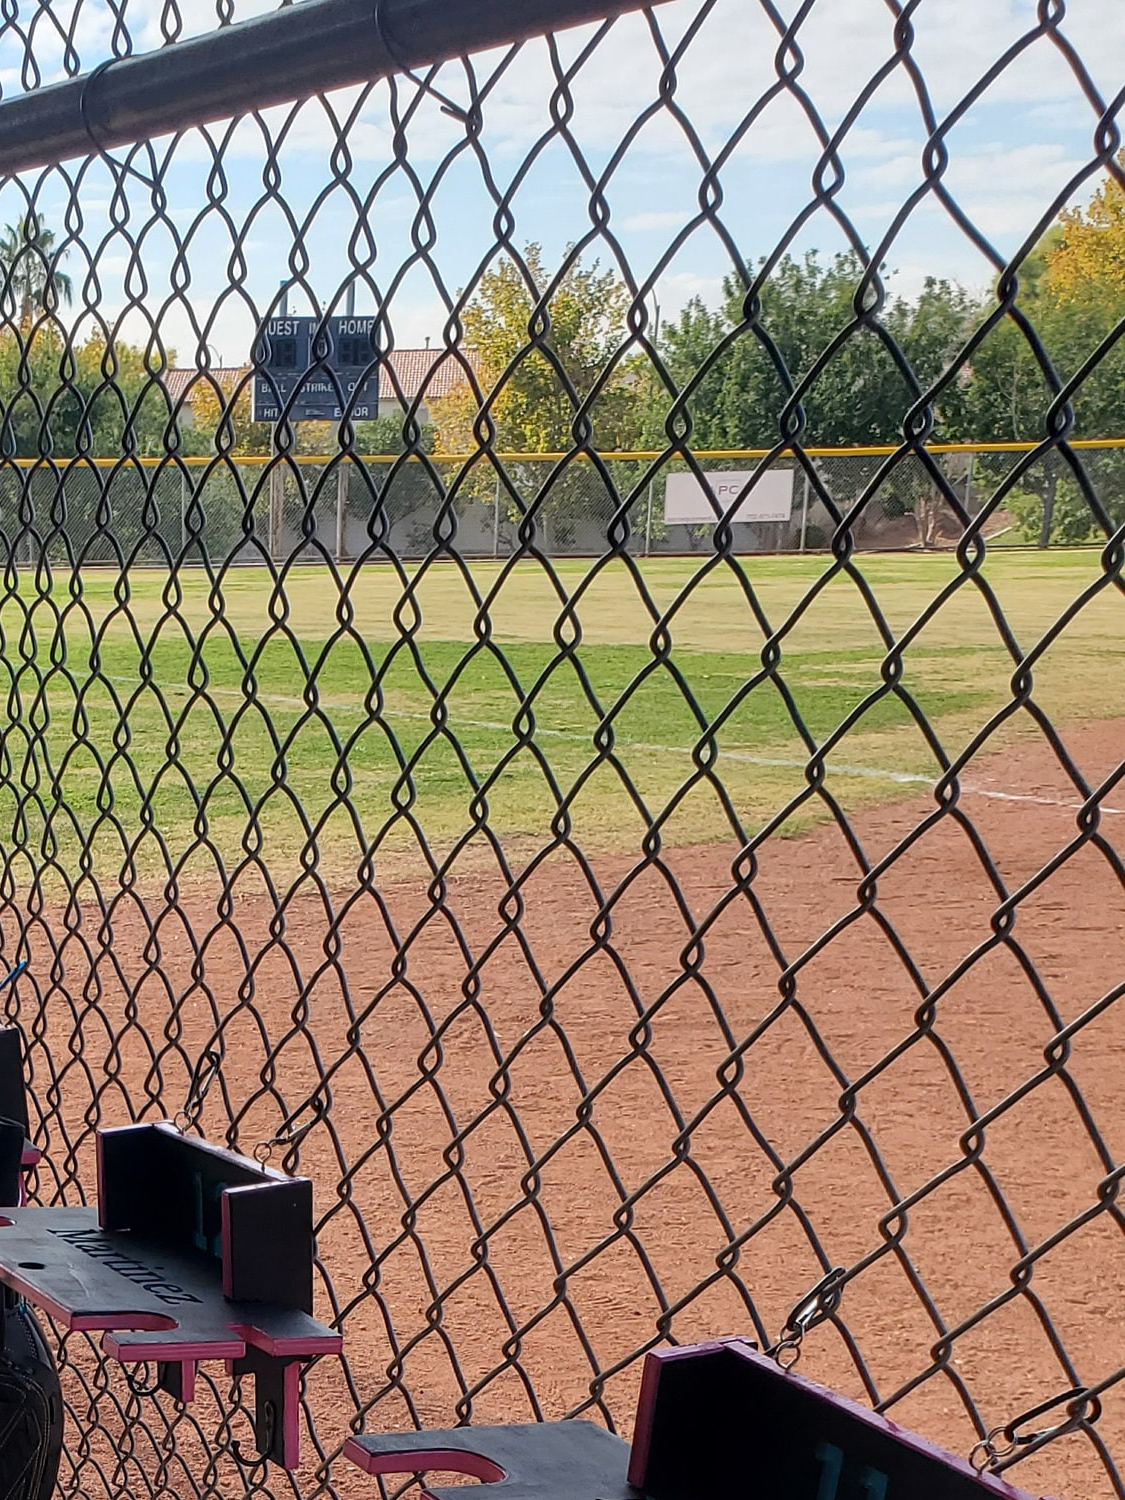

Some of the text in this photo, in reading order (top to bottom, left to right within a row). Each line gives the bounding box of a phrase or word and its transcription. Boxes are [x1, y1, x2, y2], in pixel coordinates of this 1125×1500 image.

[263, 320, 299, 335] UEST
[262, 383, 286, 393] BL
[347, 382, 368, 392] OT
[334, 407, 369, 417] EOR
[46, 1229, 204, 1306] Martinez
